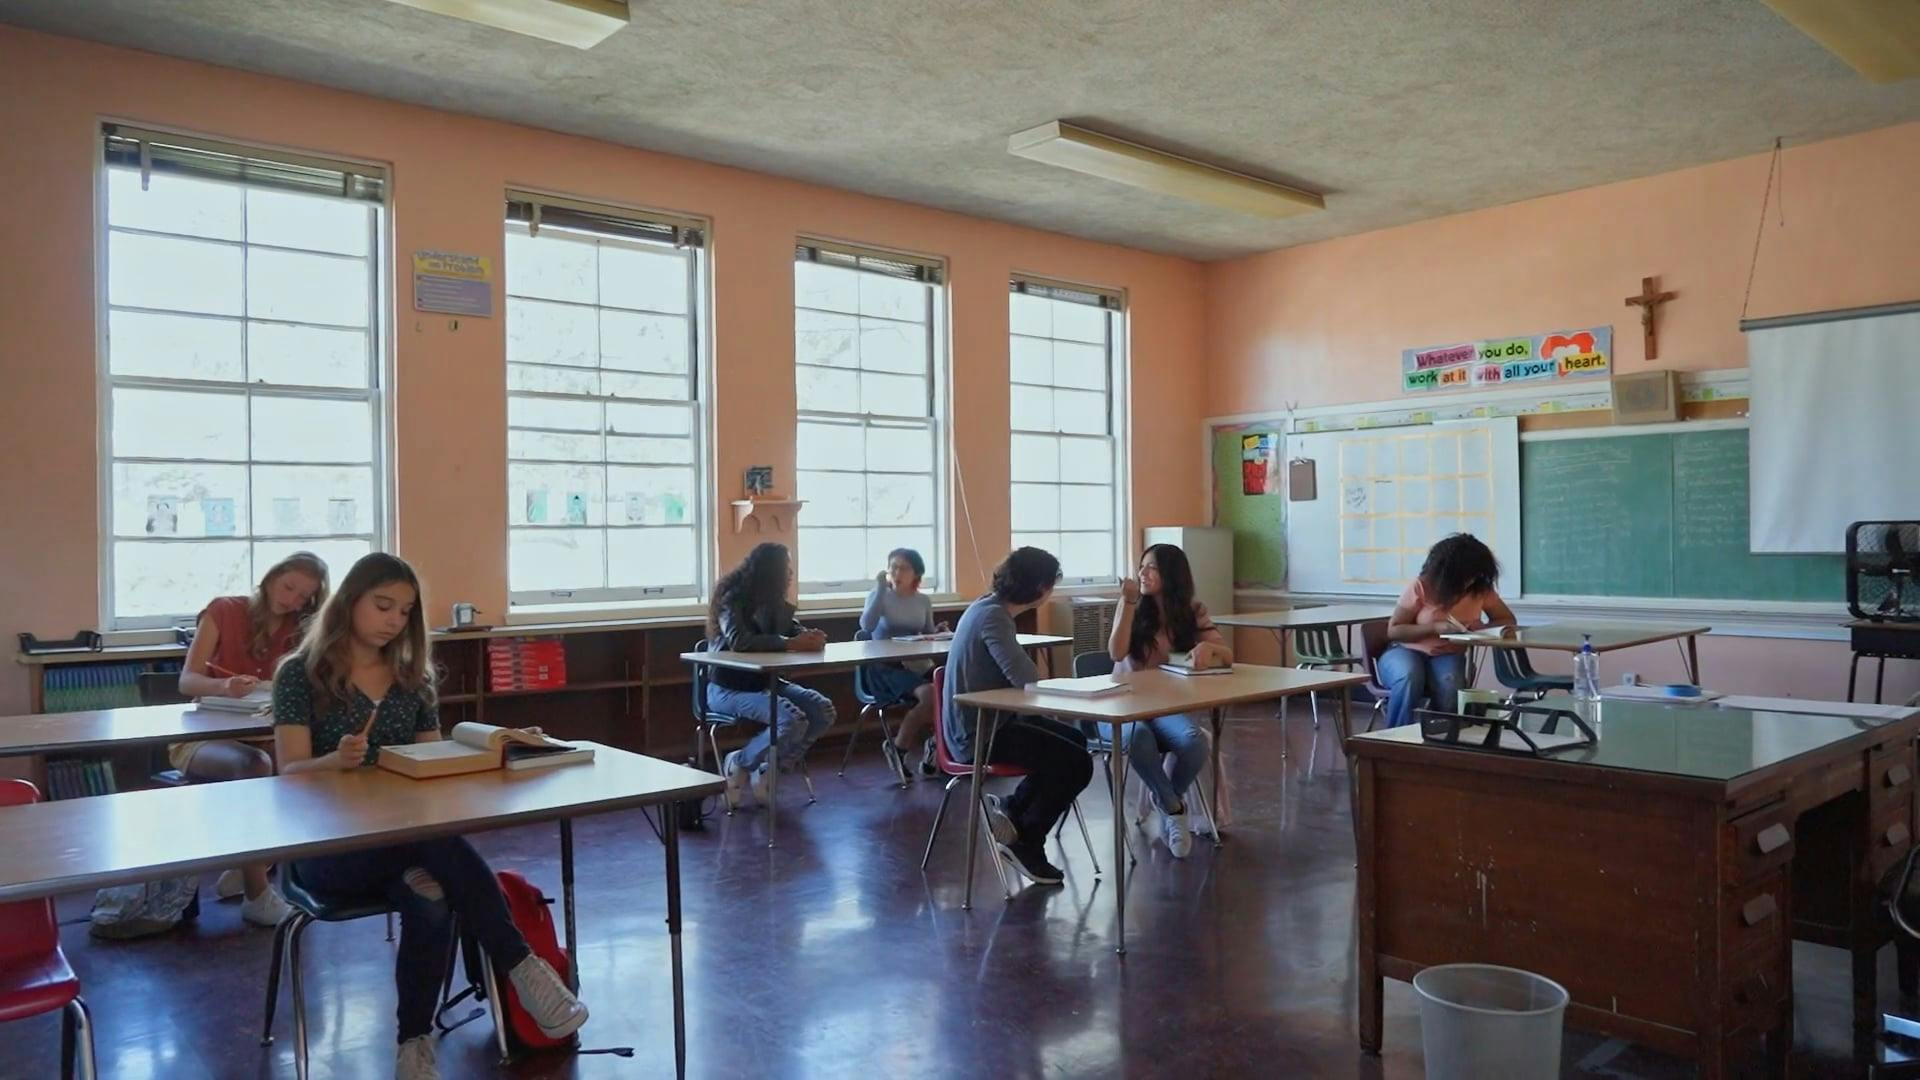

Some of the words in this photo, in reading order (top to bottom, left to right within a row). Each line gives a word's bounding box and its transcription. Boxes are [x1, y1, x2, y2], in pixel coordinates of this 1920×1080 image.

[1408, 370, 1438, 385] work
[1443, 372, 1456, 383] at
[1458, 369, 1467, 381] it
[1476, 366, 1501, 382] with
[1504, 365, 1520, 379] all
[1523, 361, 1556, 378] your
[1565, 354, 1606, 369] heart.
[1416, 346, 1474, 369] Whatever
[1478, 346, 1502, 361] you
